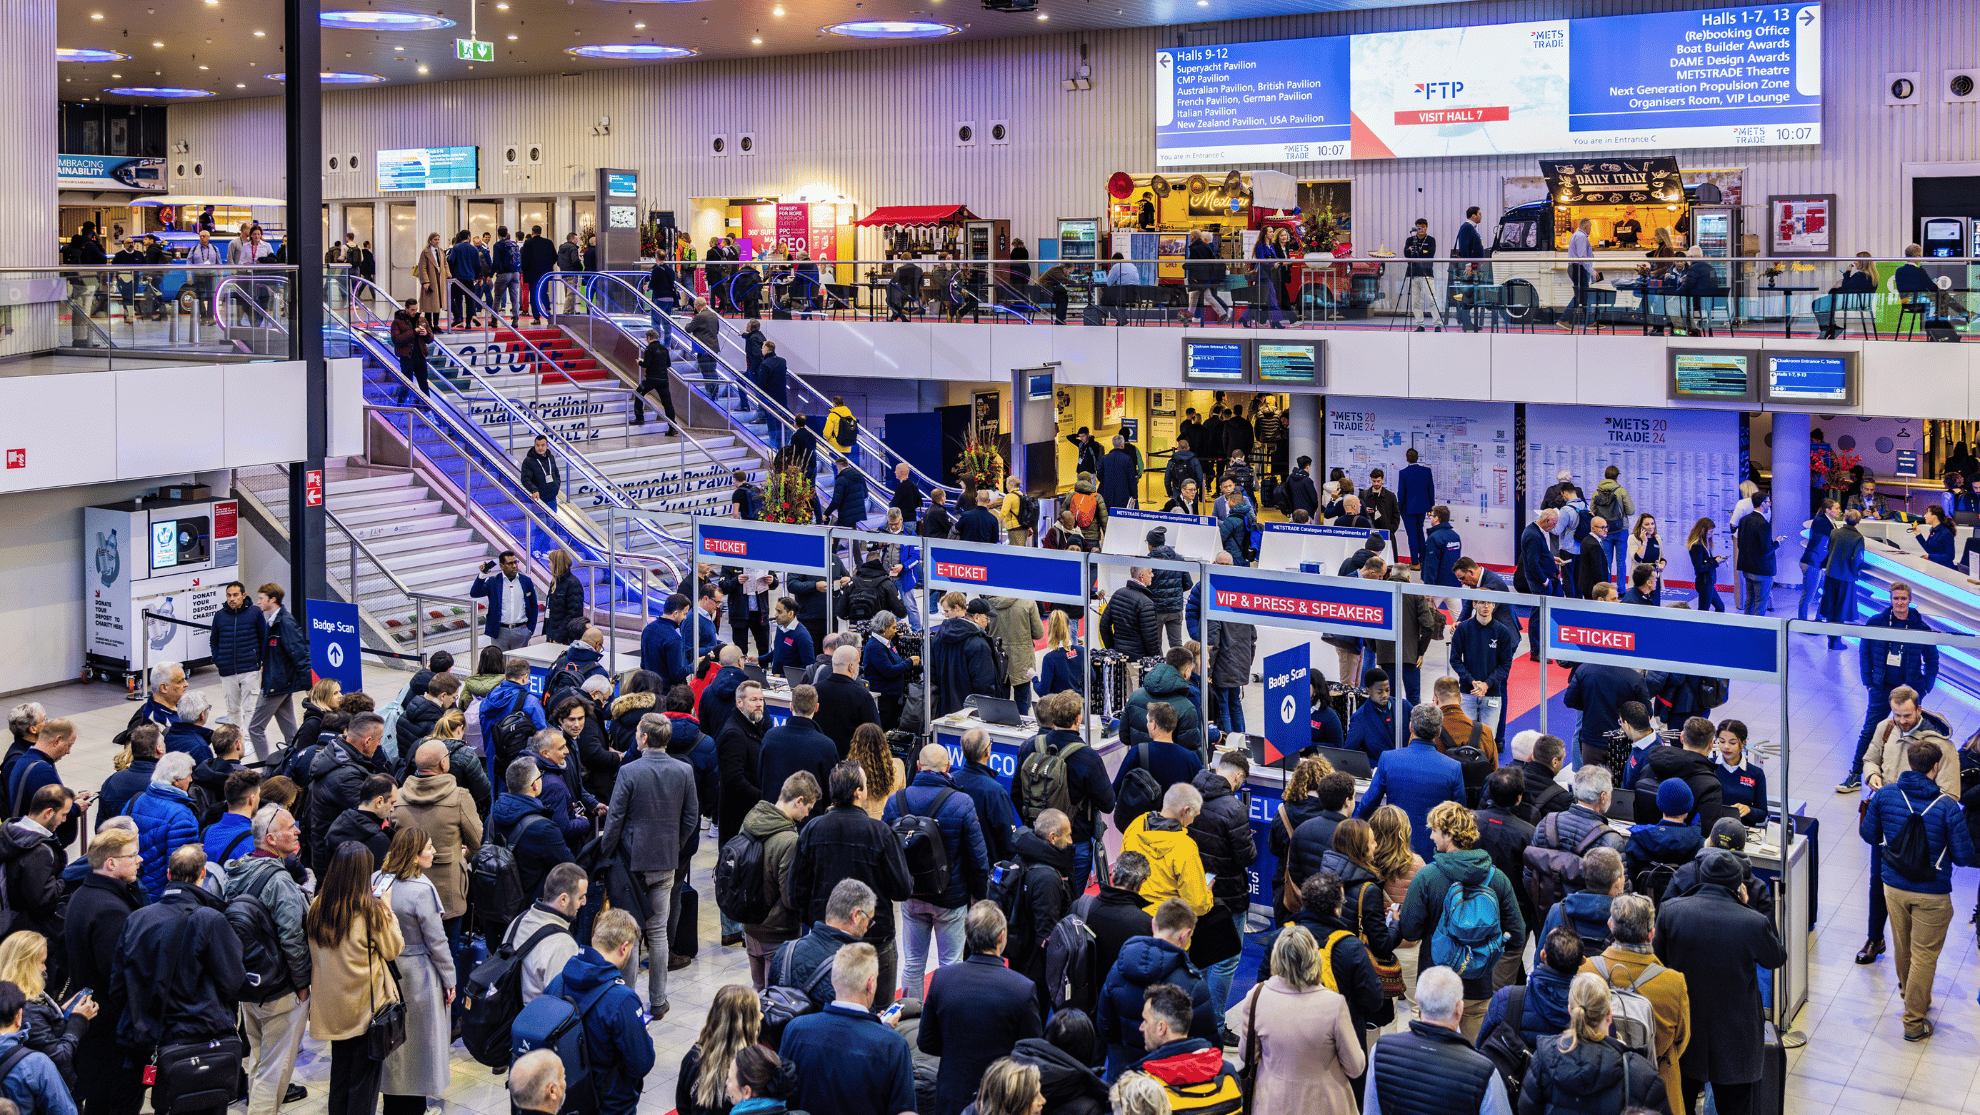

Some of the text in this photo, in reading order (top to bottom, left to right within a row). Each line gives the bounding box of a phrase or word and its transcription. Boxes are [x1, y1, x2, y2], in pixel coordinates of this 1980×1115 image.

[1702, 8, 1790, 27] Halls 1-7, 13
[1536, 30, 1564, 39] METS
[1685, 25, 1790, 44] (Re)booking Office
[1533, 39, 1564, 48] TRADE
[1676, 39, 1790, 54] Boat Builder Awards
[1177, 48, 1228, 61] Halls 9-12
[1670, 52, 1790, 68] DAME Design Awards
[1176, 60, 1257, 75] Superyacht Pavilion
[1676, 65, 1790, 80] METSTRADE Theatre
[1176, 73, 1230, 84] CMP Pavilion
[1177, 79, 1321, 96] Australian Pavilion, British Pavilion
[1426, 82, 1464, 100] FTP
[1609, 79, 1790, 97] Next Generation Propulsion Zone
[1176, 91, 1312, 106] French Pavilion, German Pavilion
[1629, 92, 1790, 110] Organisers Room, VIP Lounge
[1176, 107, 1237, 118] Italian Pavilion
[1419, 110, 1483, 122] VISIT HALL 7
[1177, 113, 1324, 130] New Zealand Pavilion, USA Pavilion
[1737, 127, 1765, 136] METS
[1776, 127, 1812, 140] 10:07
[1573, 137, 1588, 146] You
[1604, 136, 1612, 144] in
[1614, 135, 1649, 144] Entrance
[1650, 134, 1657, 143] C
[1735, 135, 1765, 144] TRADE
[1287, 144, 1309, 153] METS
[1317, 144, 1345, 156] 10:07
[1160, 152, 1173, 161] You
[1185, 152, 1191, 160] in
[1192, 151, 1219, 160] Entrance
[1285, 152, 1309, 160] TRADE
[58, 159, 104, 169] MBRACING
[58, 167, 104, 176] AINABILITY
[1575, 172, 1647, 184] DAILY ITALY
[1190, 190, 1249, 211] Mexian
[1335, 412, 1376, 422] METS 20
[1332, 421, 1375, 431] TRADE 24
[1612, 418, 1667, 431] METS 20
[1608, 430, 1666, 443] TRADE 24
[1333, 529, 1361, 537] compliments
[704, 539, 746, 554] E-TICKET
[936, 563, 986, 580] E-TICKET
[193, 591, 217, 600] DONATE
[95, 600, 112, 608] DONATE
[193, 599, 210, 607] YOUR
[193, 604, 218, 614] DEPOSIT
[1217, 592, 1383, 622] VIP & PRESS & SPEAKERS
[95, 606, 107, 614] YOUR
[193, 611, 218, 621] CHARITY
[95, 614, 112, 622] DEPOSIT
[95, 620, 124, 631] CHARITY HERE
[313, 617, 355, 635] Badge Scan
[1560, 627, 1633, 648] E-TICKET
[1268, 666, 1307, 690] Badge Scan
